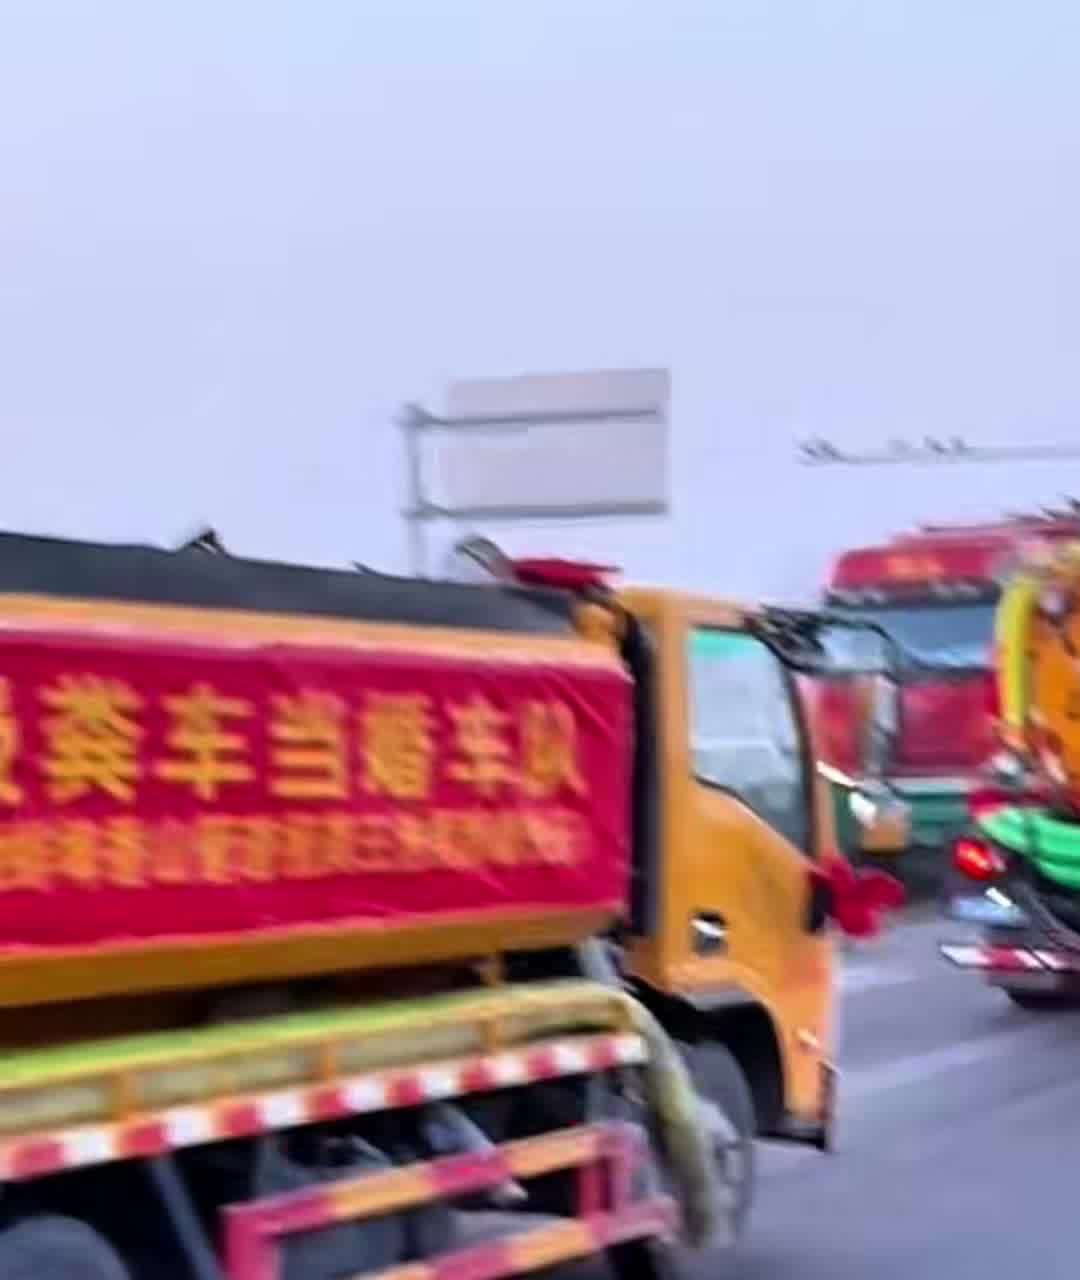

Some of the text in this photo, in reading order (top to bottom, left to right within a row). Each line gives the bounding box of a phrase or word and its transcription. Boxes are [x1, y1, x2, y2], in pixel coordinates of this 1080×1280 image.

[0, 671, 588, 805] 粪车当婚车队
